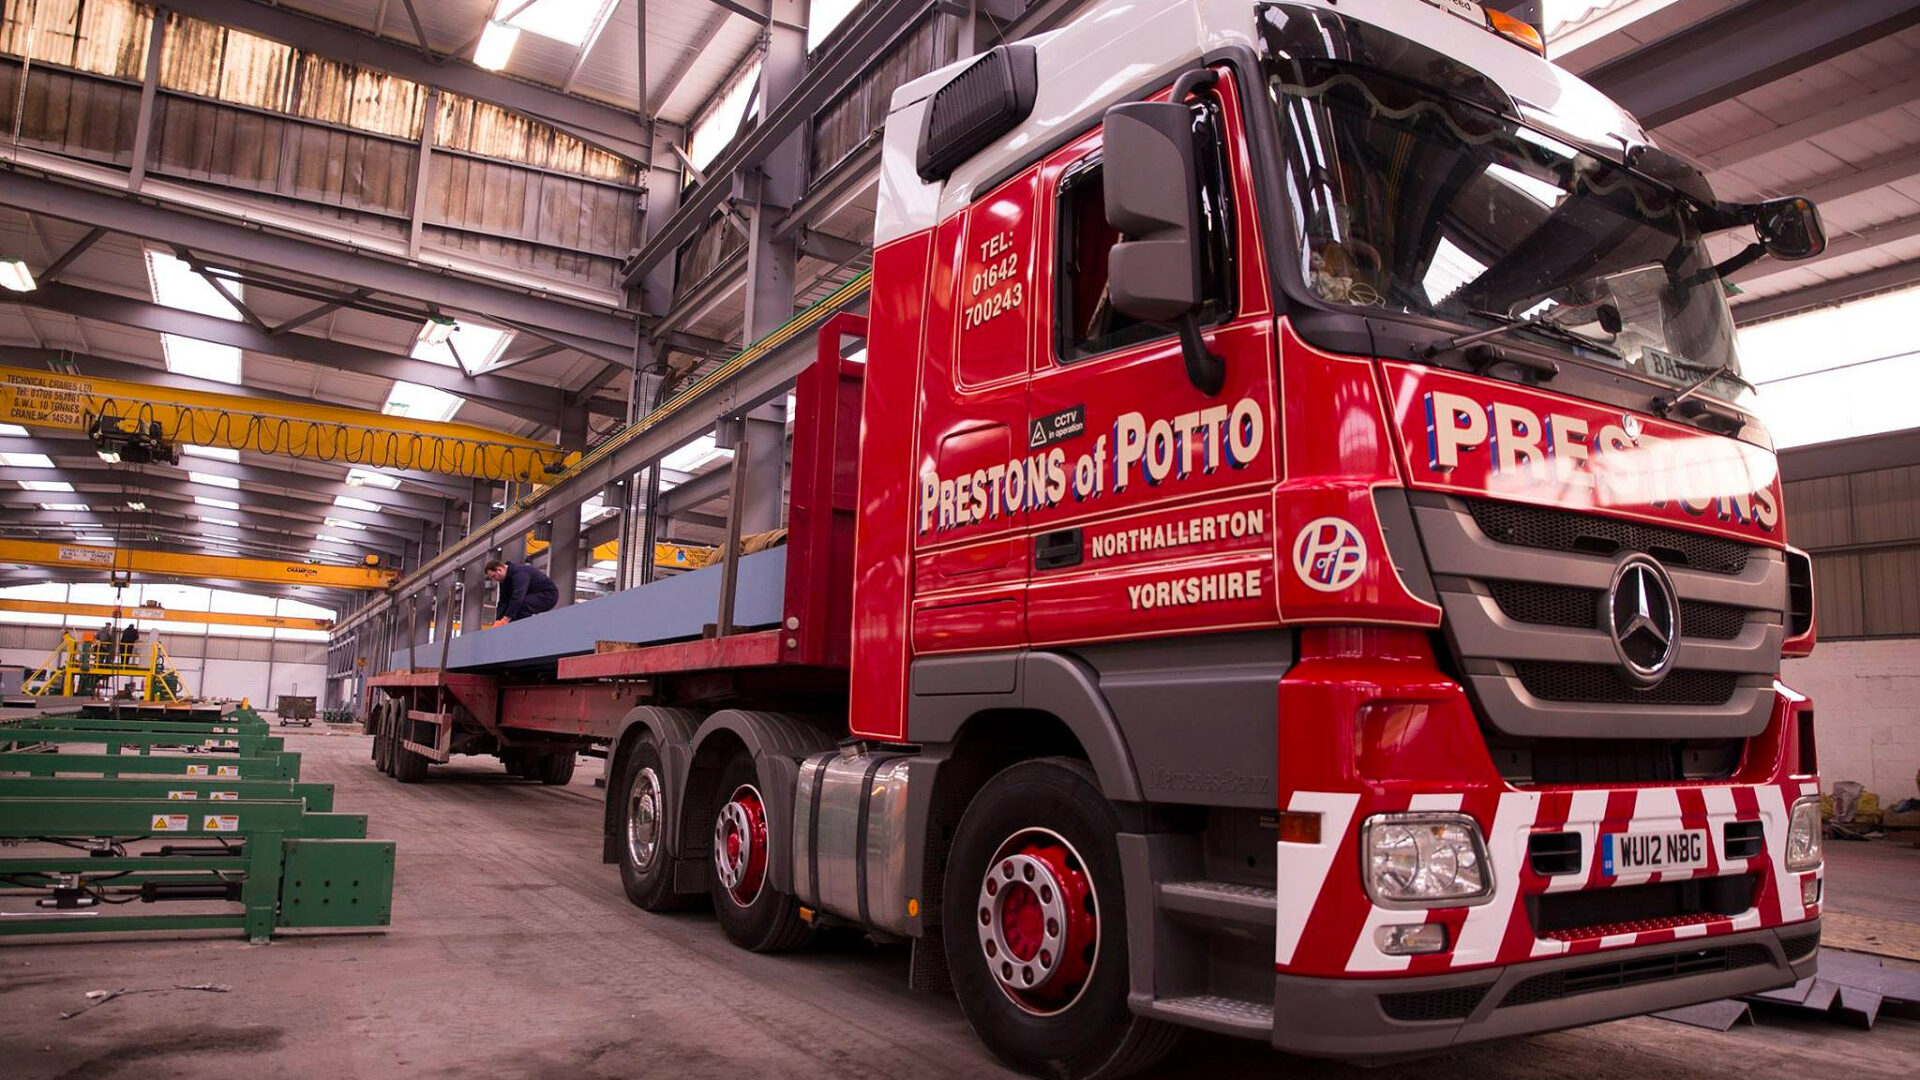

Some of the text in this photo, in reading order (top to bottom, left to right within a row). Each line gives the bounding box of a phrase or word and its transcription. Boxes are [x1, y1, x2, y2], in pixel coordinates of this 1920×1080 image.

[980, 231, 1013, 262] TEL:
[972, 252, 1018, 296] 01642
[965, 282, 1022, 330] 700243
[7, 374, 46, 387] TECHNICAL
[48, 379, 77, 391] CRANES
[10, 408, 37, 420] CRANE
[1048, 422, 1083, 439] in operation
[1054, 410, 1077, 428] CCTV
[920, 398, 1264, 535] PRESTONS of POTTO
[1092, 509, 1264, 559] NORTHALLERTON
[1128, 569, 1262, 611] YORKSHIRE
[1620, 833, 1701, 867] WU12 NBG
